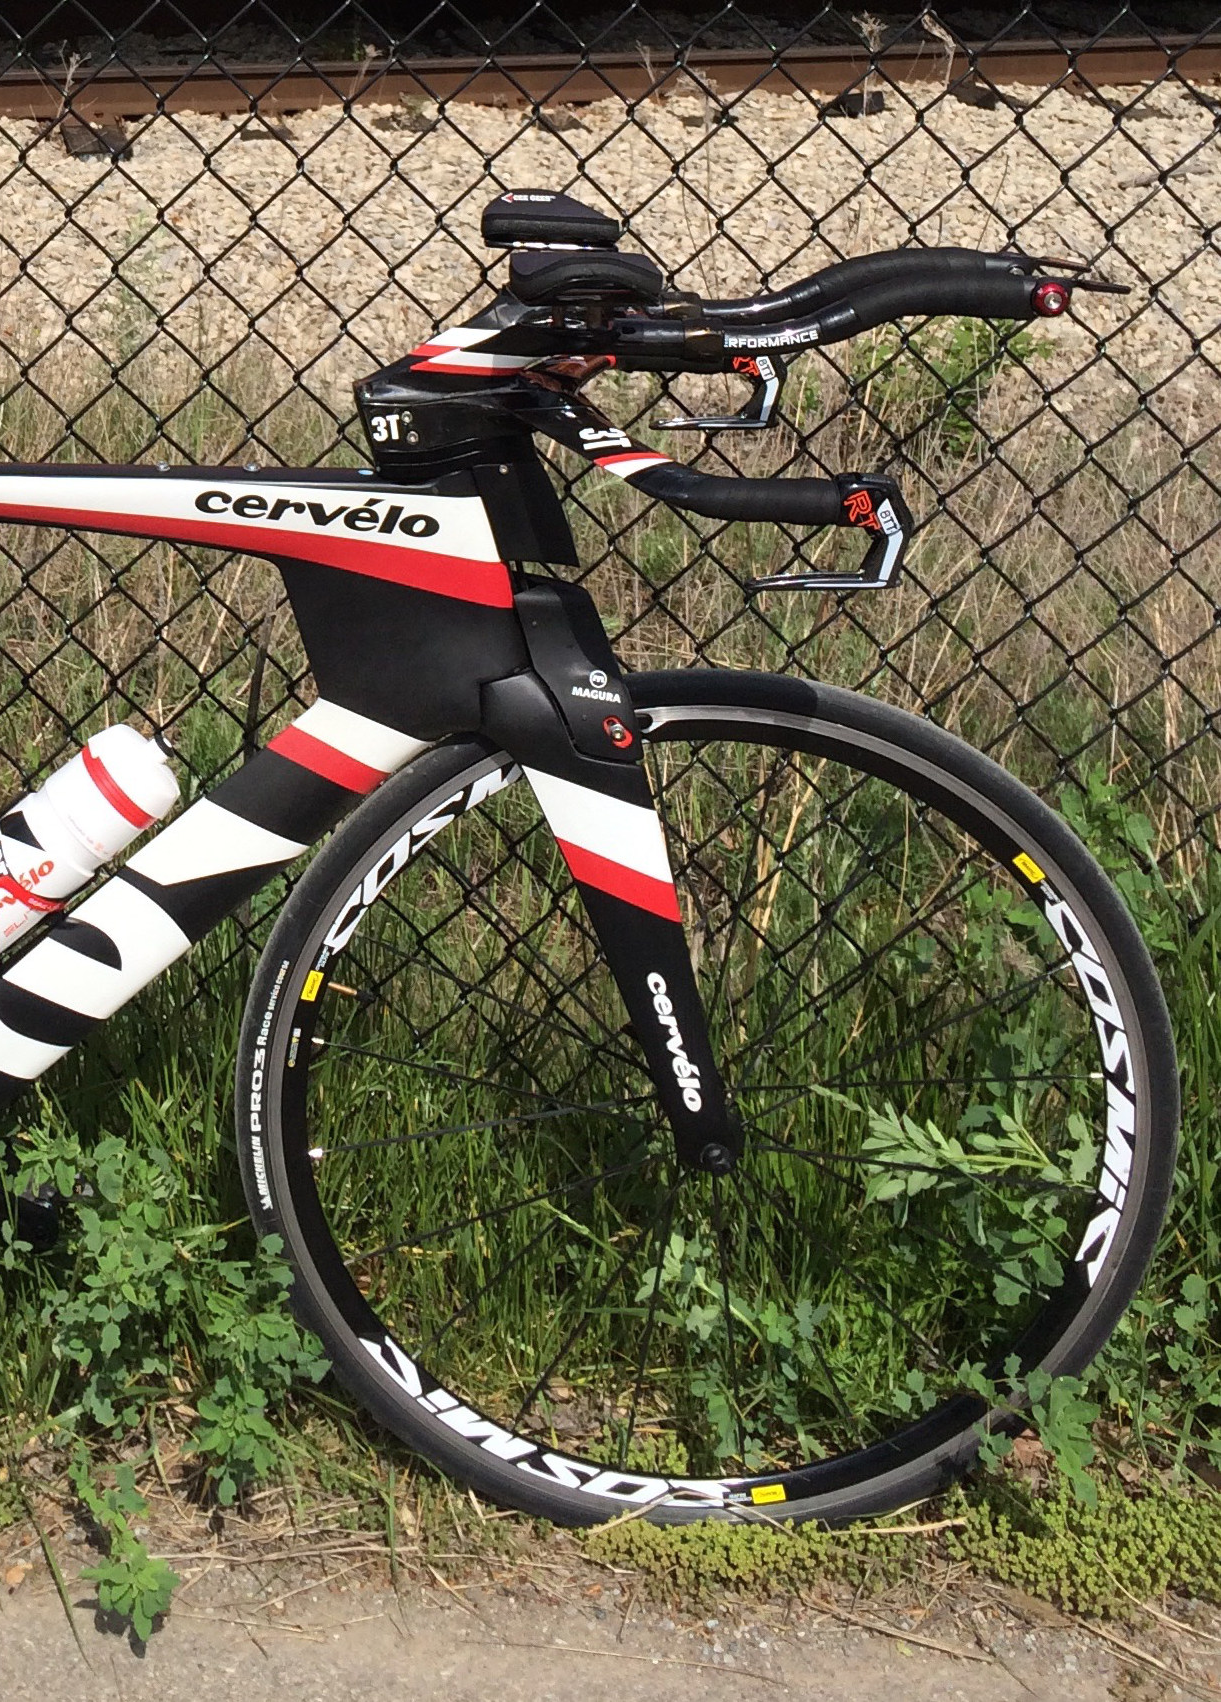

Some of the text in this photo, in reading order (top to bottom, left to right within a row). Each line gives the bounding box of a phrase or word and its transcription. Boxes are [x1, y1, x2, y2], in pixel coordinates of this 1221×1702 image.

[371, 414, 401, 442] 3T
[579, 427, 632, 451] 3T
[195, 490, 440, 539] cervélo
[571, 686, 622, 704] MAGURA
[257, 1010, 273, 1046] Race
[646, 971, 703, 1113] cervélo
[250, 1048, 266, 1132] PRO3
[251, 1136, 268, 1197] MICHELIN
